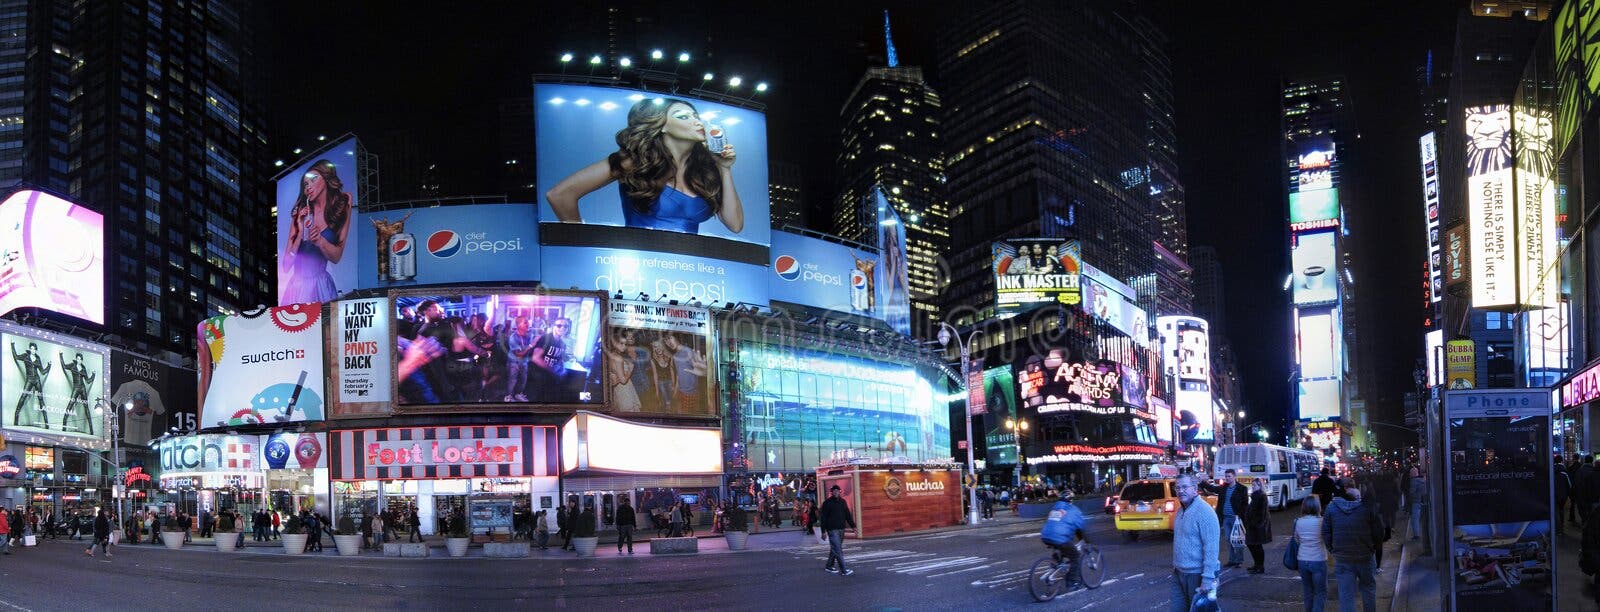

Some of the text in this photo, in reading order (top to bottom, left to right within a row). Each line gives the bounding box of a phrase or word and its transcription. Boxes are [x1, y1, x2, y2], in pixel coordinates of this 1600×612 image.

[1483, 181, 1493, 228] NOTHING
[1495, 213, 1503, 221] IS
[1290, 218, 1339, 231] TOSHIBA
[465, 232, 486, 240] diet
[1485, 232, 1494, 253] ELSE
[1495, 225, 1505, 261] SIMPLY
[643, 257, 695, 272] refreshes
[697, 262, 715, 274] like
[717, 267, 725, 275] a
[803, 262, 819, 271] diet
[1485, 257, 1494, 278] LIKE
[803, 270, 843, 286] pepsi
[997, 274, 1080, 289] INK MASTER
[655, 278, 725, 304] pepsi
[345, 302, 378, 316] I JUST
[610, 303, 614, 312] I
[656, 307, 666, 316] MY
[344, 315, 374, 329] WANT
[344, 329, 359, 342] MY
[344, 341, 378, 356] PANTS
[1448, 344, 1473, 353] BUBBA
[241, 349, 295, 366] swatch
[344, 355, 372, 370] BACK
[1450, 355, 1471, 363] GUMP
[123, 364, 159, 381] FAMOUS
[1467, 396, 1529, 407] Phone
[1096, 406, 1107, 415] ALL
[174, 411, 197, 431] 15
[999, 433, 1016, 442] RIVE
[368, 440, 518, 465] Foot Locker
[1455, 471, 1536, 480] International recharges
[905, 478, 945, 491] nuchas
